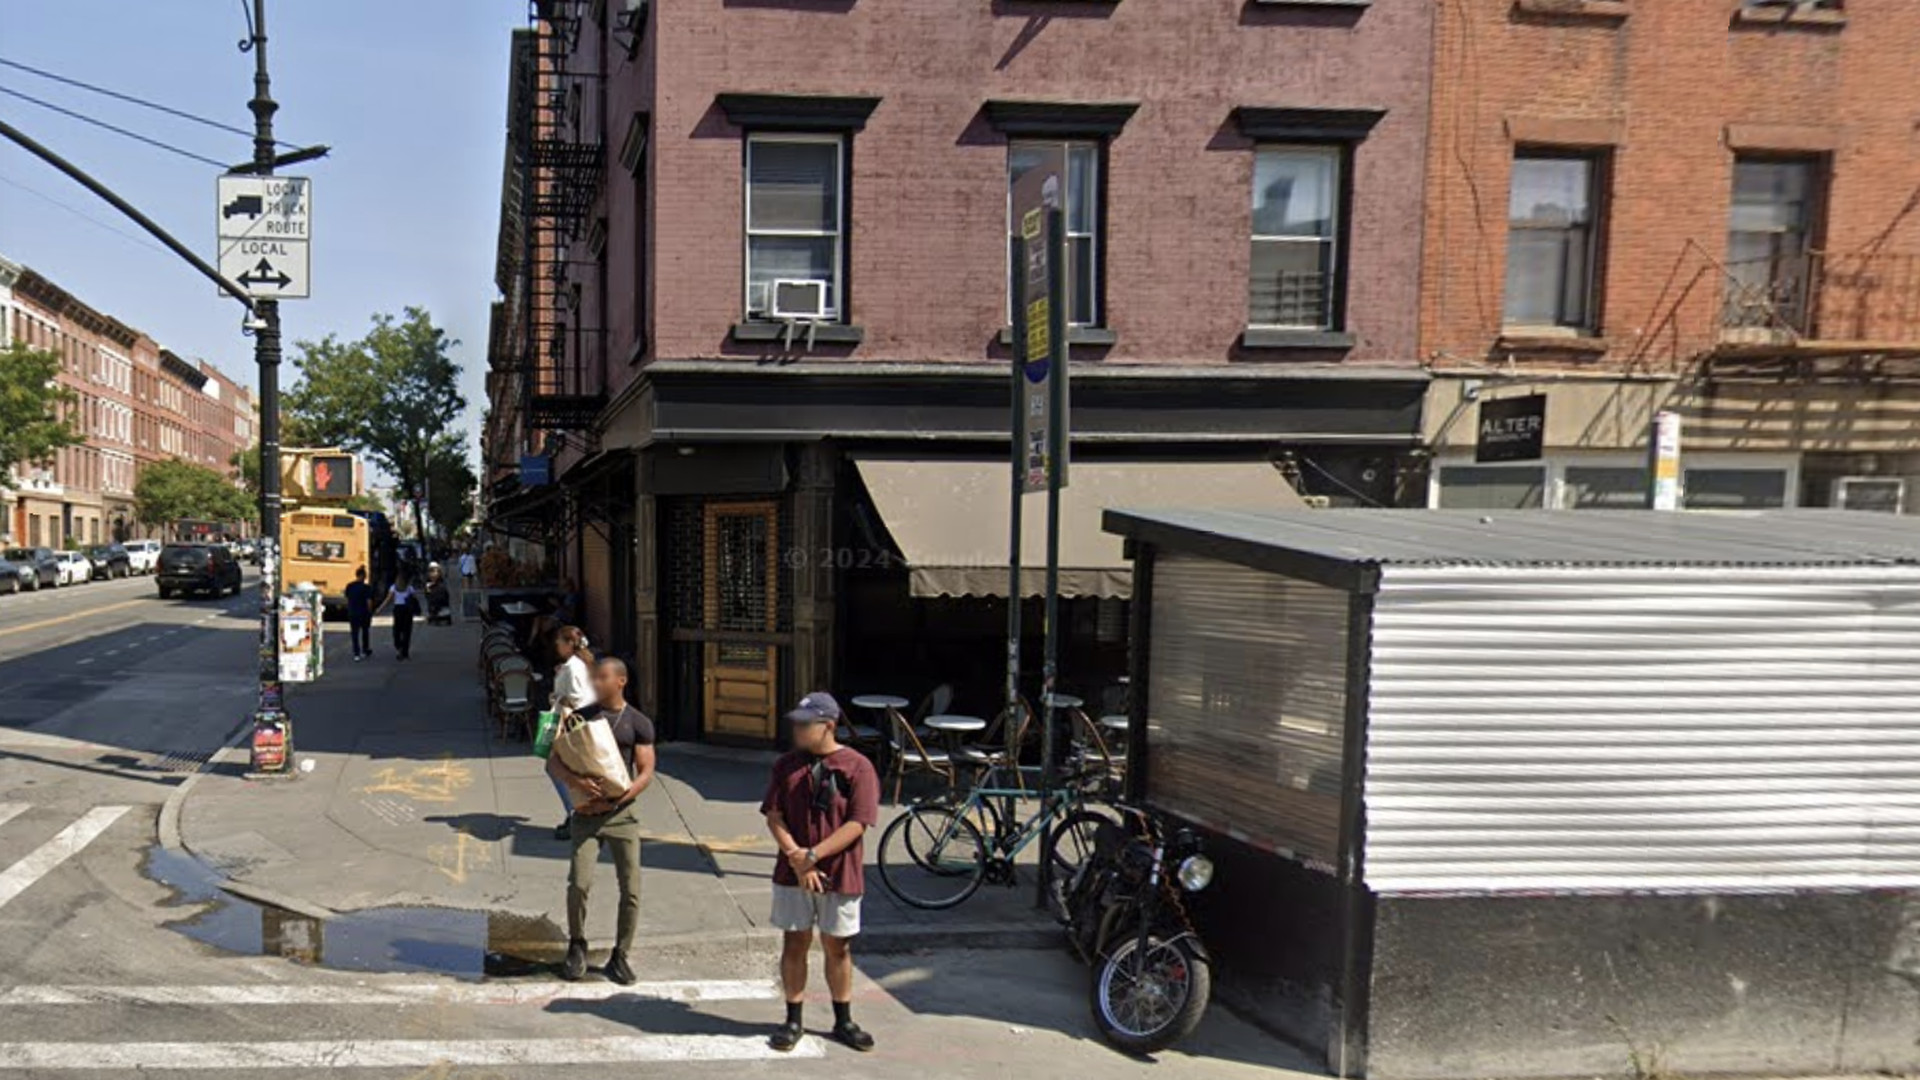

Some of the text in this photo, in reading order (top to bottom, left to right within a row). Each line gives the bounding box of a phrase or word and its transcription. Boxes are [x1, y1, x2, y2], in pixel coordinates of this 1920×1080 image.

[266, 183, 305, 197] LOCAL
[267, 202, 305, 215] TRUCK
[266, 221, 306, 235] ROUTE
[241, 242, 288, 256] LOCAL
[1481, 415, 1541, 434] ALTER
